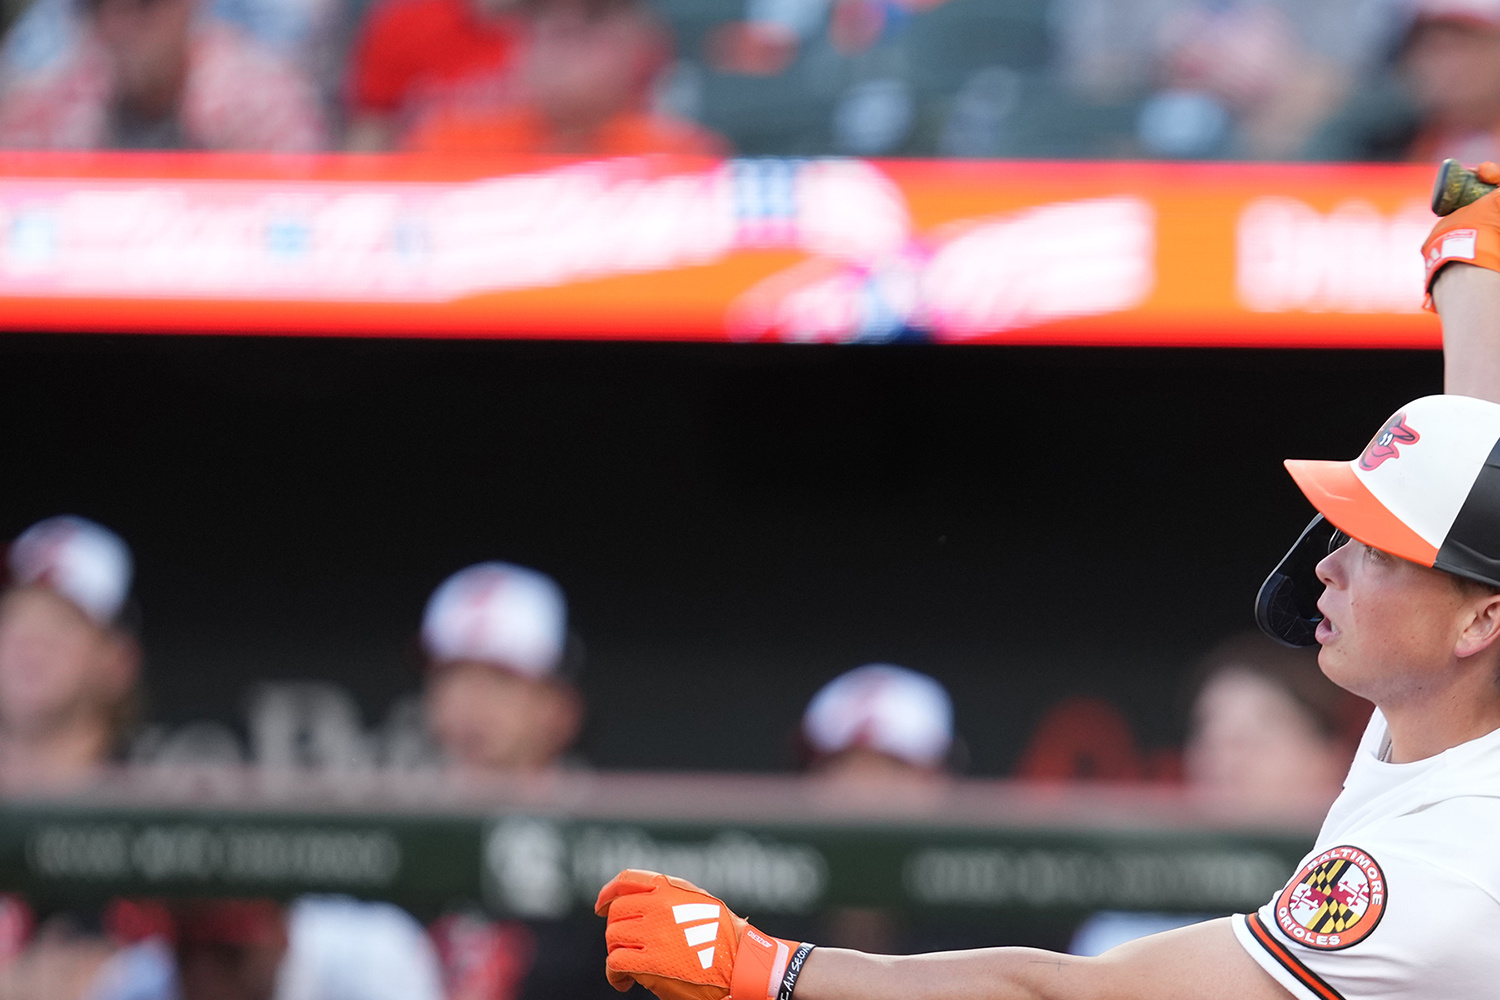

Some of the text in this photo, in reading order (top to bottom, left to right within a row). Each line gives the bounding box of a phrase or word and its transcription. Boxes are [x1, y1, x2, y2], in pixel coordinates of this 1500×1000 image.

[1306, 848, 1383, 906] BALTIMORE
[1278, 906, 1342, 946] ORIOLES
[783, 971, 797, 991] AM
